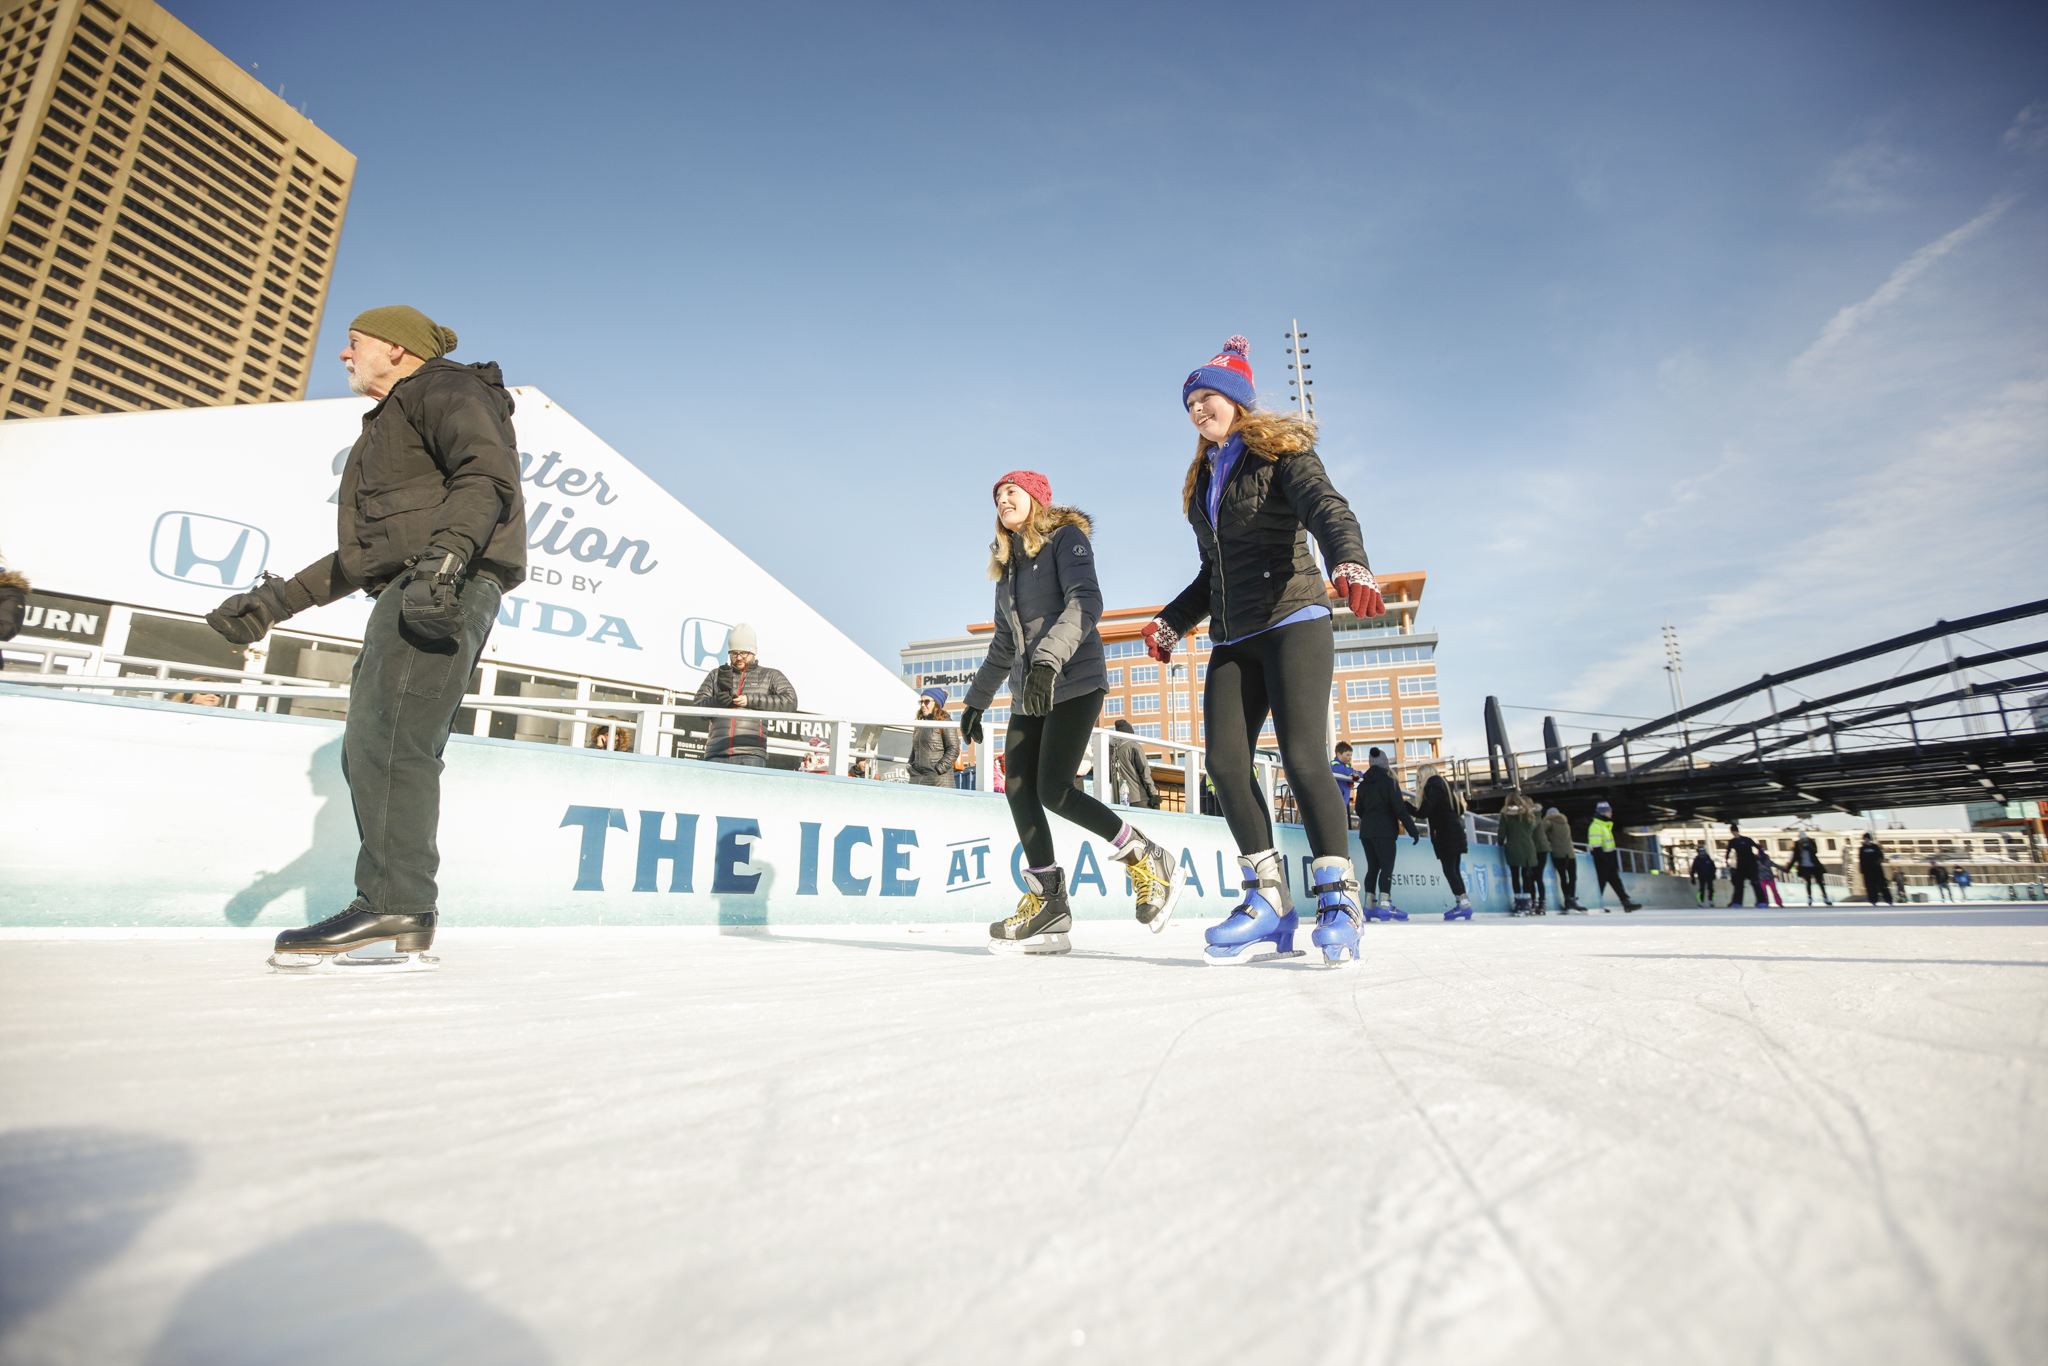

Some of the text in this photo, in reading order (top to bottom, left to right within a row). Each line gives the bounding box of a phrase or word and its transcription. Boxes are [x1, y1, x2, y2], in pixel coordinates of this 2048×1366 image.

[571, 572, 603, 595] BY
[23, 605, 99, 635] URN
[498, 594, 644, 651] NDA
[923, 673, 959, 686] Phillips
[559, 805, 763, 895] THE
[796, 821, 920, 897] ICE
[946, 844, 992, 887] AT
[1391, 873, 1440, 887] SENTED BY
